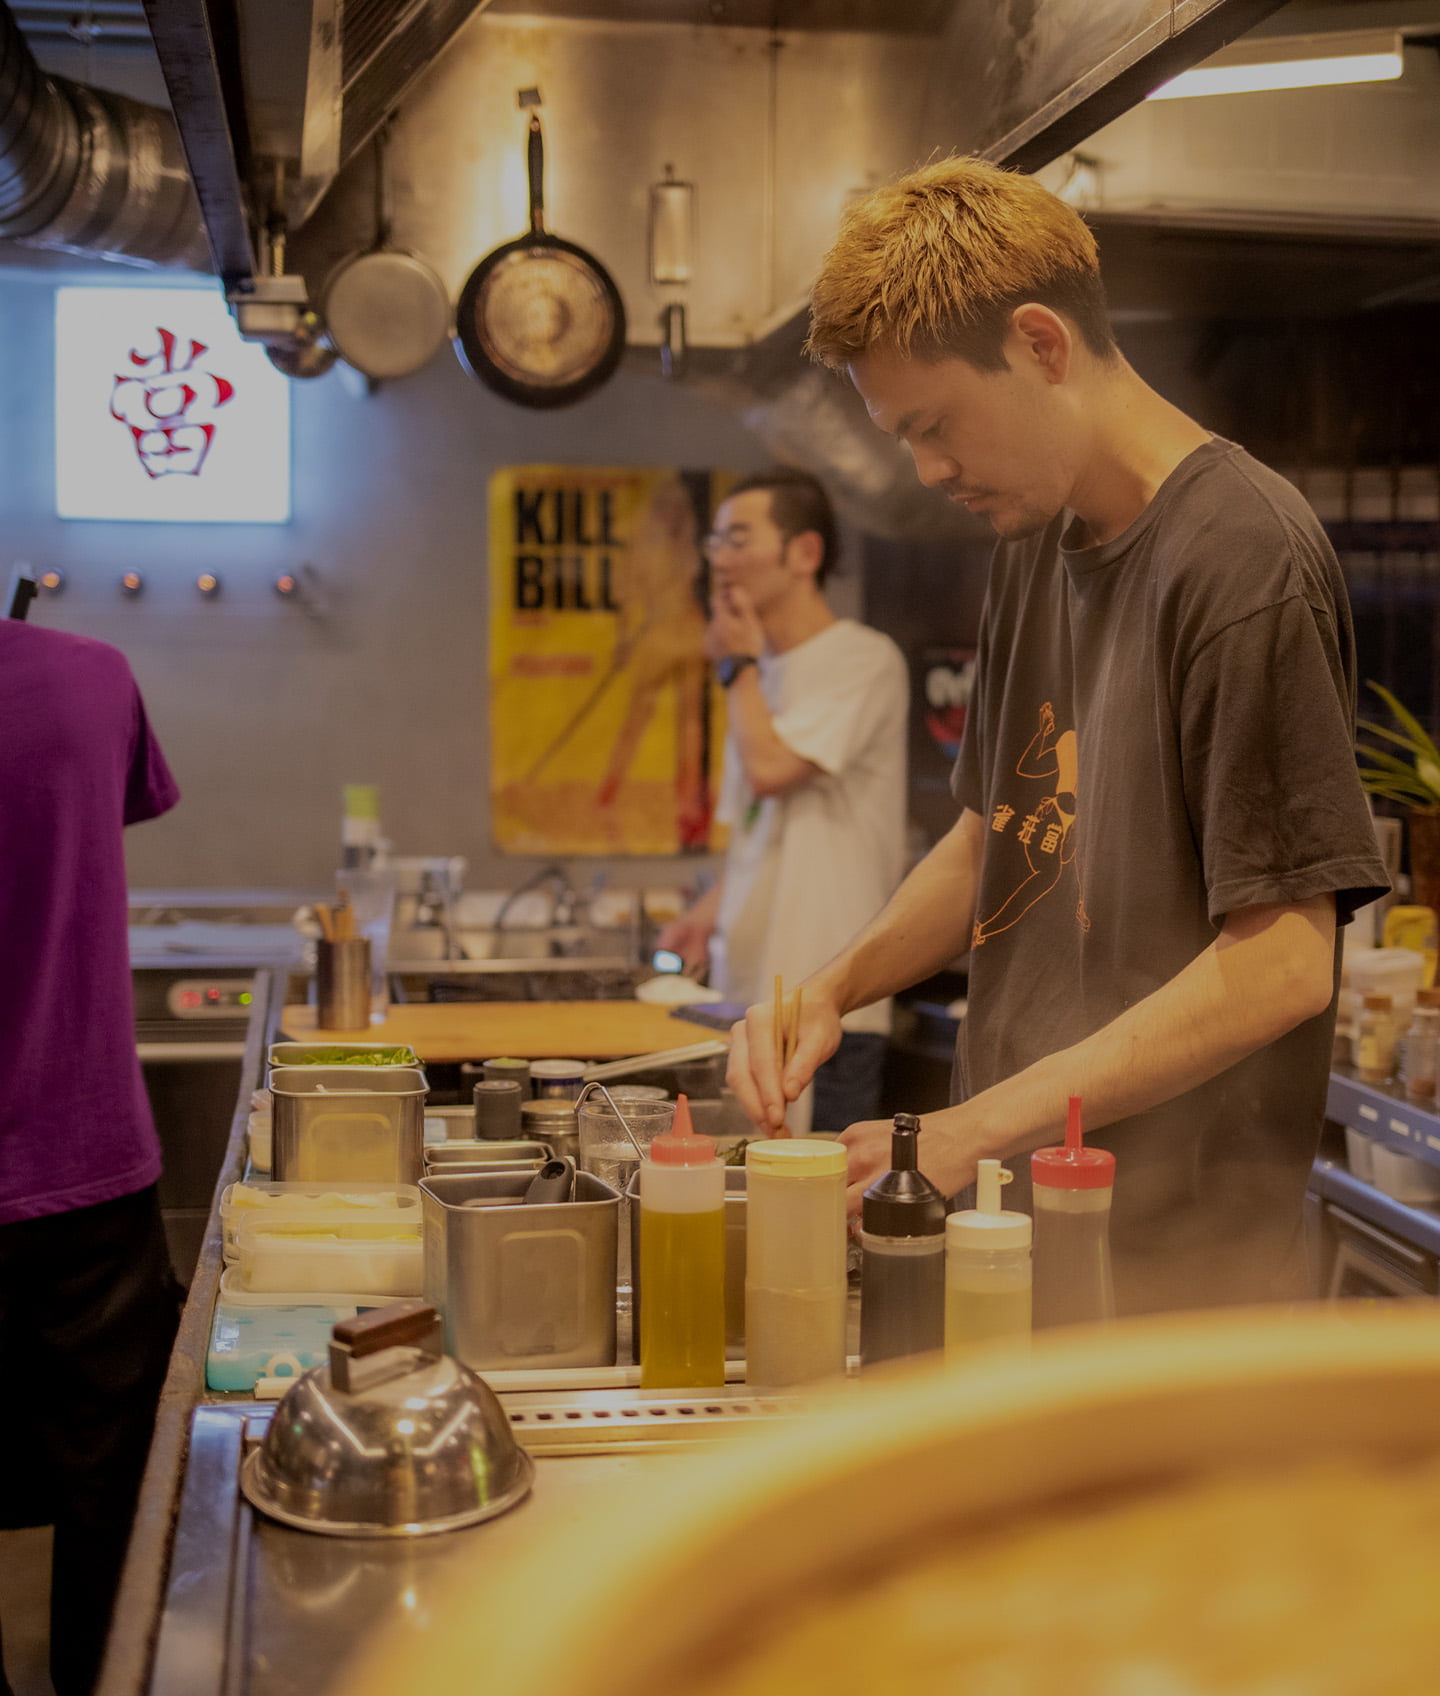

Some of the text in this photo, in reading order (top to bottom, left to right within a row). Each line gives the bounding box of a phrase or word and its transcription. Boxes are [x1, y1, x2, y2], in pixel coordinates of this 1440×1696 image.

[109, 326, 236, 480] 當
[516, 489, 624, 547] KILL
[516, 555, 622, 612] BILL
